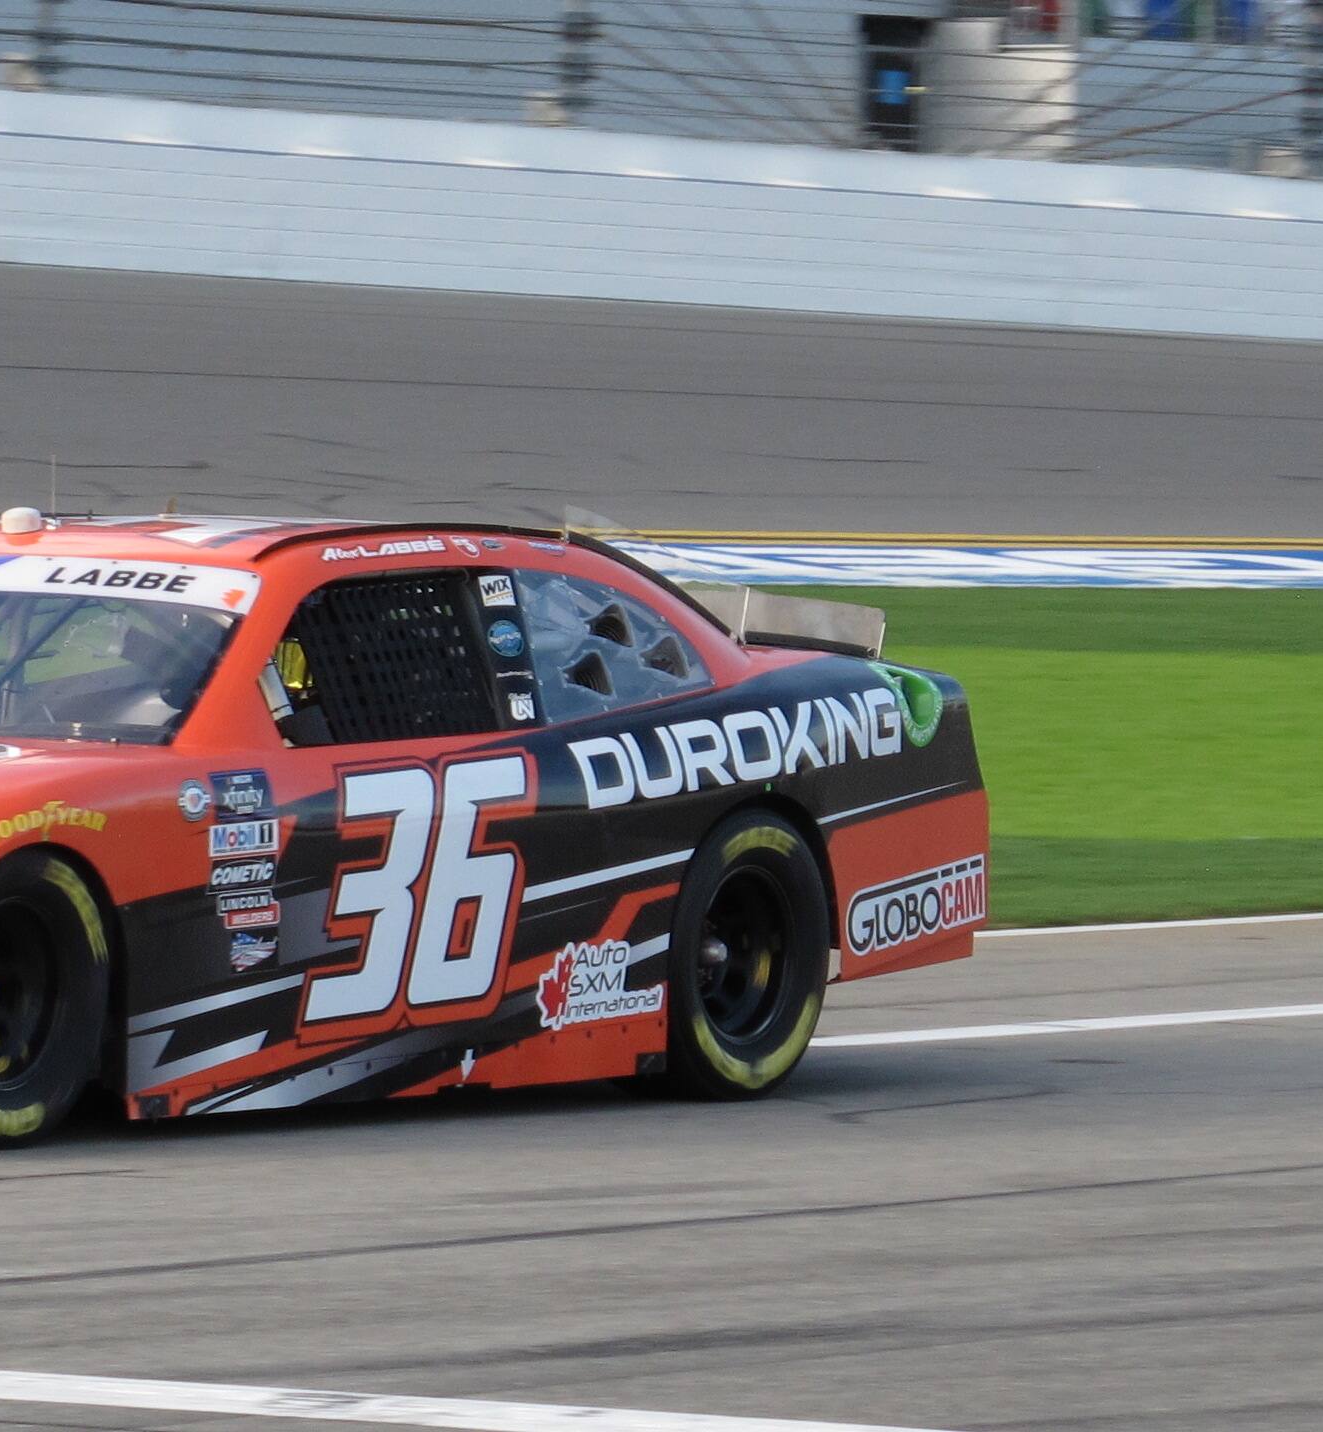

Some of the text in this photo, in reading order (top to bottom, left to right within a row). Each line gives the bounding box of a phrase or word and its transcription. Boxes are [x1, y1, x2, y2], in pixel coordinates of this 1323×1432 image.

[481, 578, 511, 596] WIX
[567, 688, 901, 811] DUROKING
[213, 824, 256, 850] Mobil
[261, 823, 273, 843] 1
[211, 862, 274, 886] COMETIC
[221, 894, 270, 911] LINCOLN
[303, 755, 527, 1023] 36
[232, 911, 275, 925] WELDERS
[848, 872, 985, 952] GLOBOCAM
[573, 945, 627, 970] Auto
[568, 969, 623, 998] SXM
[565, 992, 660, 1019] International
